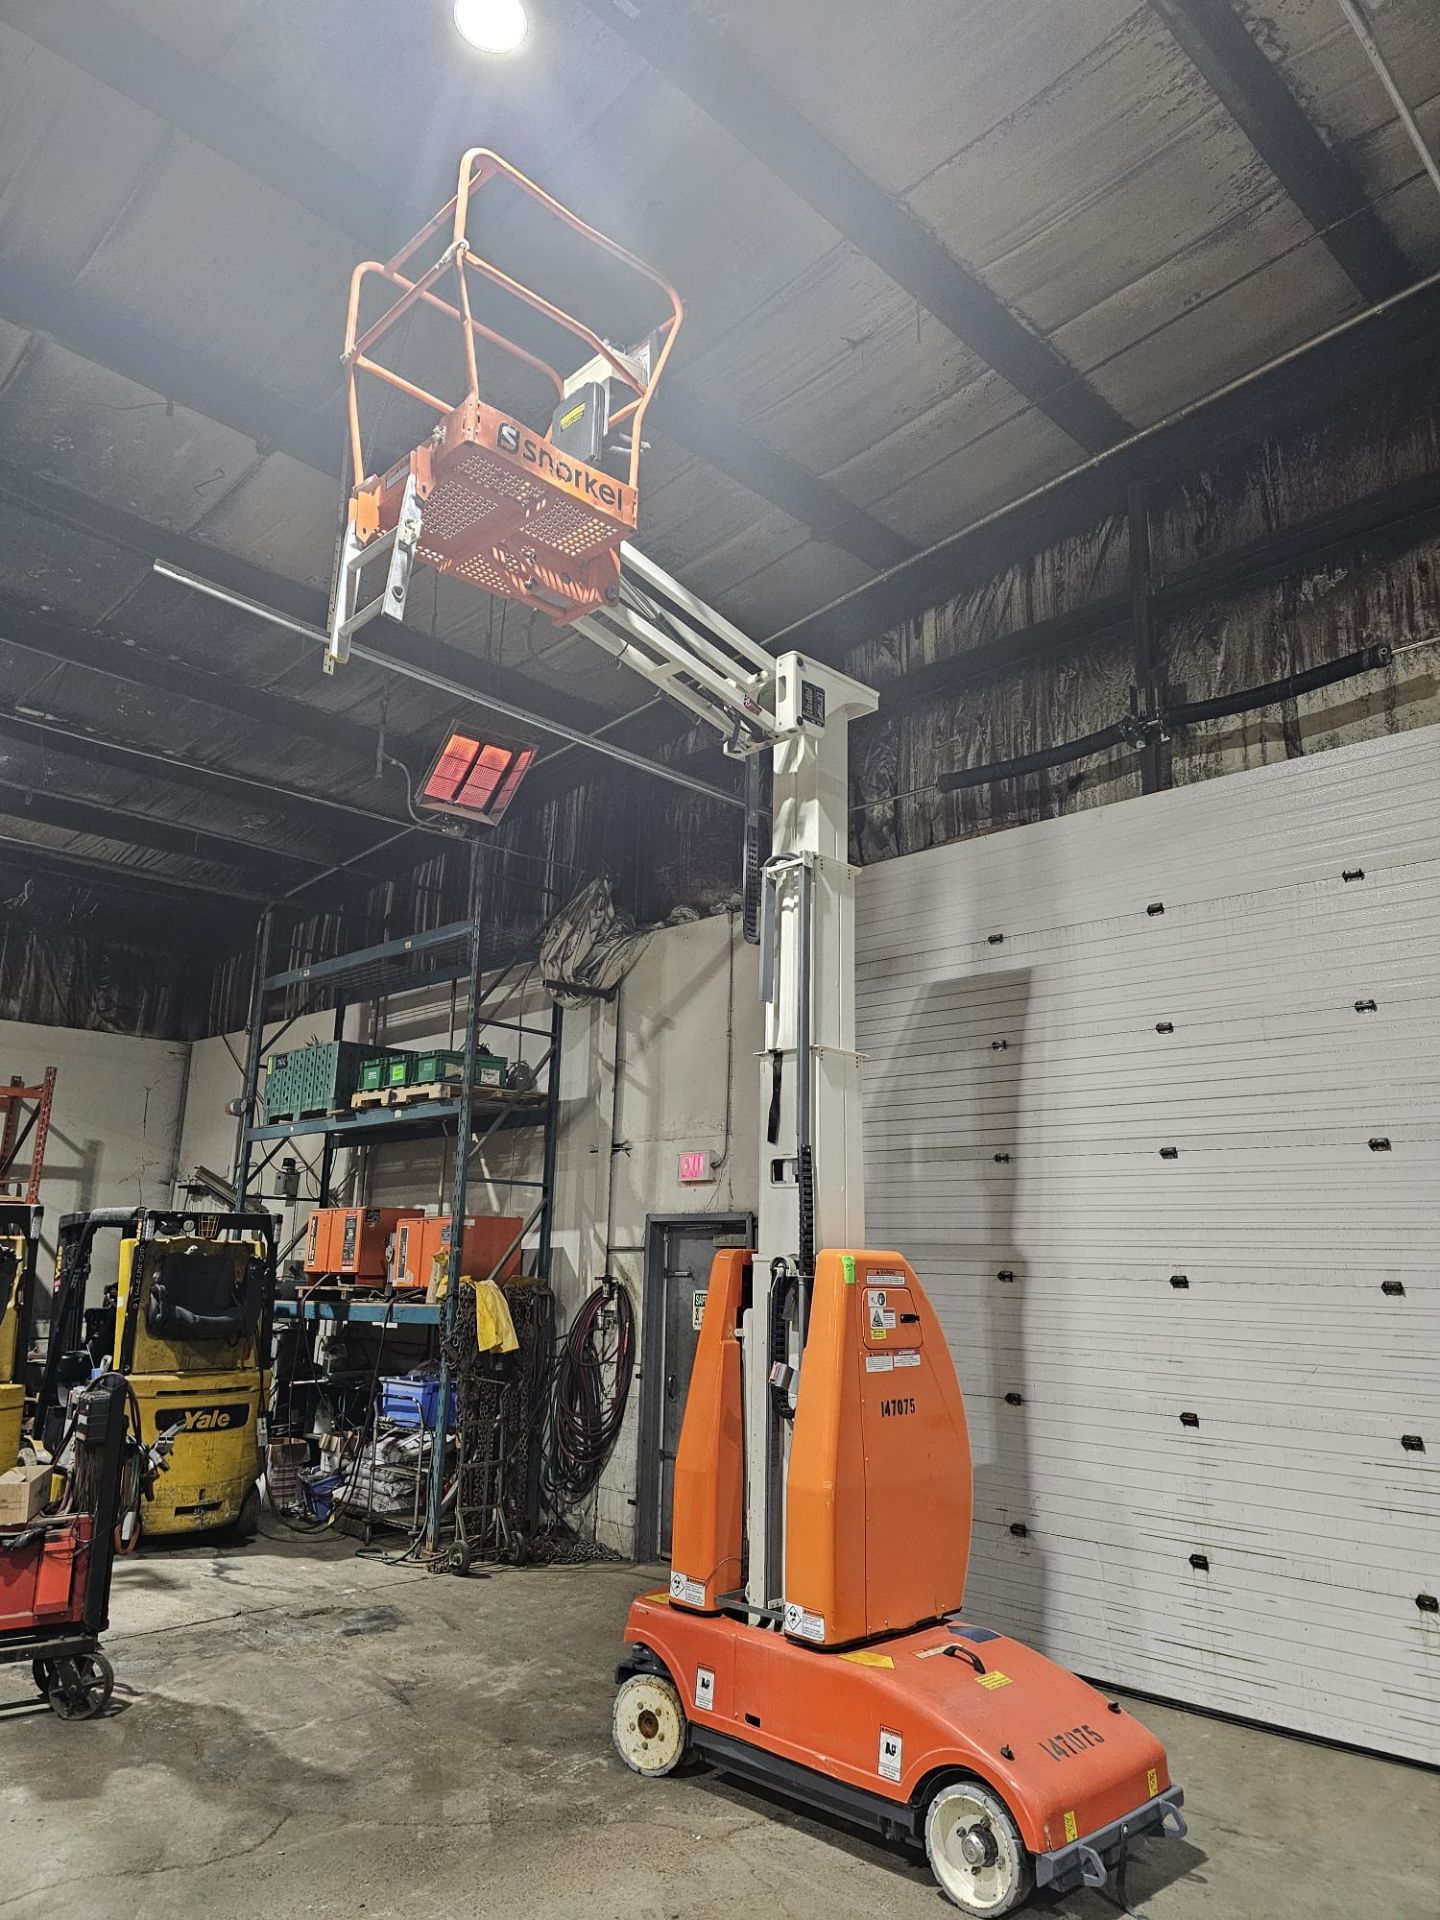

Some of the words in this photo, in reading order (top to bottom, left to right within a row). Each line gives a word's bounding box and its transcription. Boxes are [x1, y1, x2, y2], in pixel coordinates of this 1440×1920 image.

[681, 1154, 704, 1178] EXIT
[695, 1294, 708, 1306] SAF
[881, 1397, 916, 1418] 147075
[184, 1410, 230, 1430] Yale
[1038, 1724, 1105, 1762] 147075
